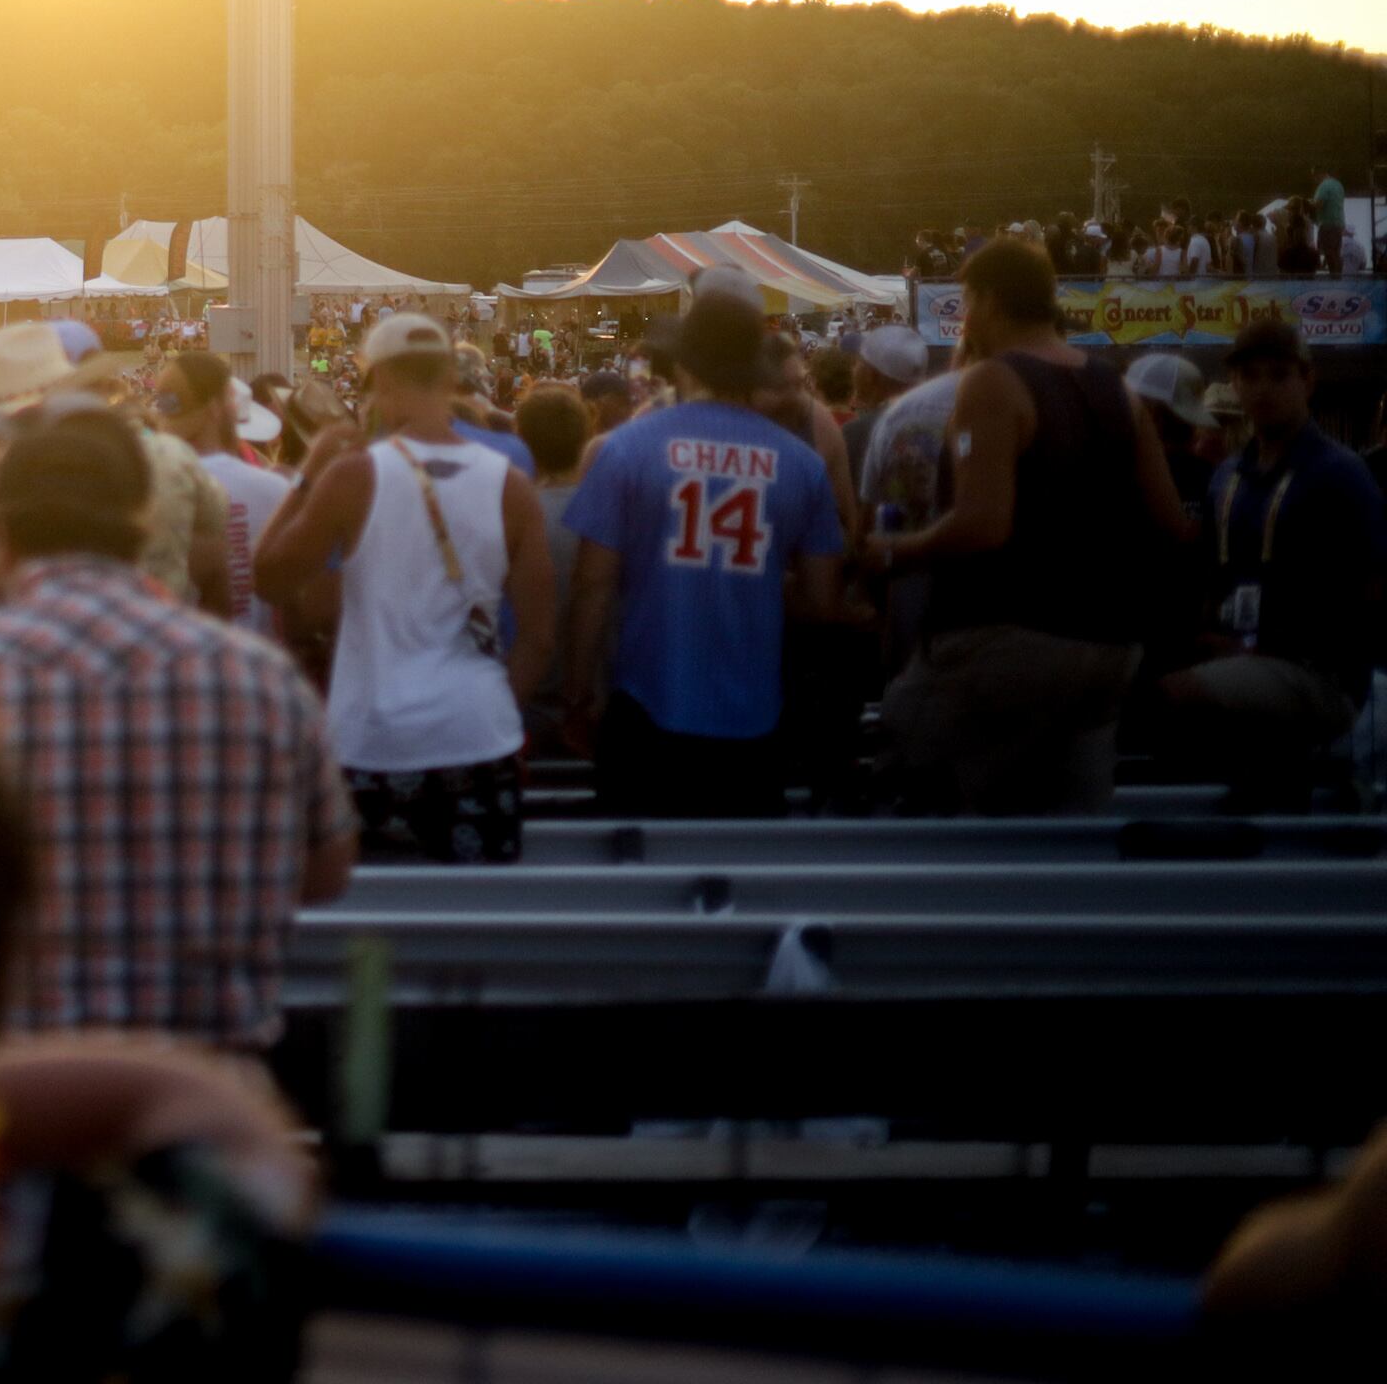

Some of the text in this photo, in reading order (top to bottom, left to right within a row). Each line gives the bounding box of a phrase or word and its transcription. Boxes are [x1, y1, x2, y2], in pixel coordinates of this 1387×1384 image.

[1180, 295, 1225, 329] Star
[1304, 324, 1362, 335] VOLVO
[668, 439, 777, 482] CHAN
[670, 477, 770, 572] 14
